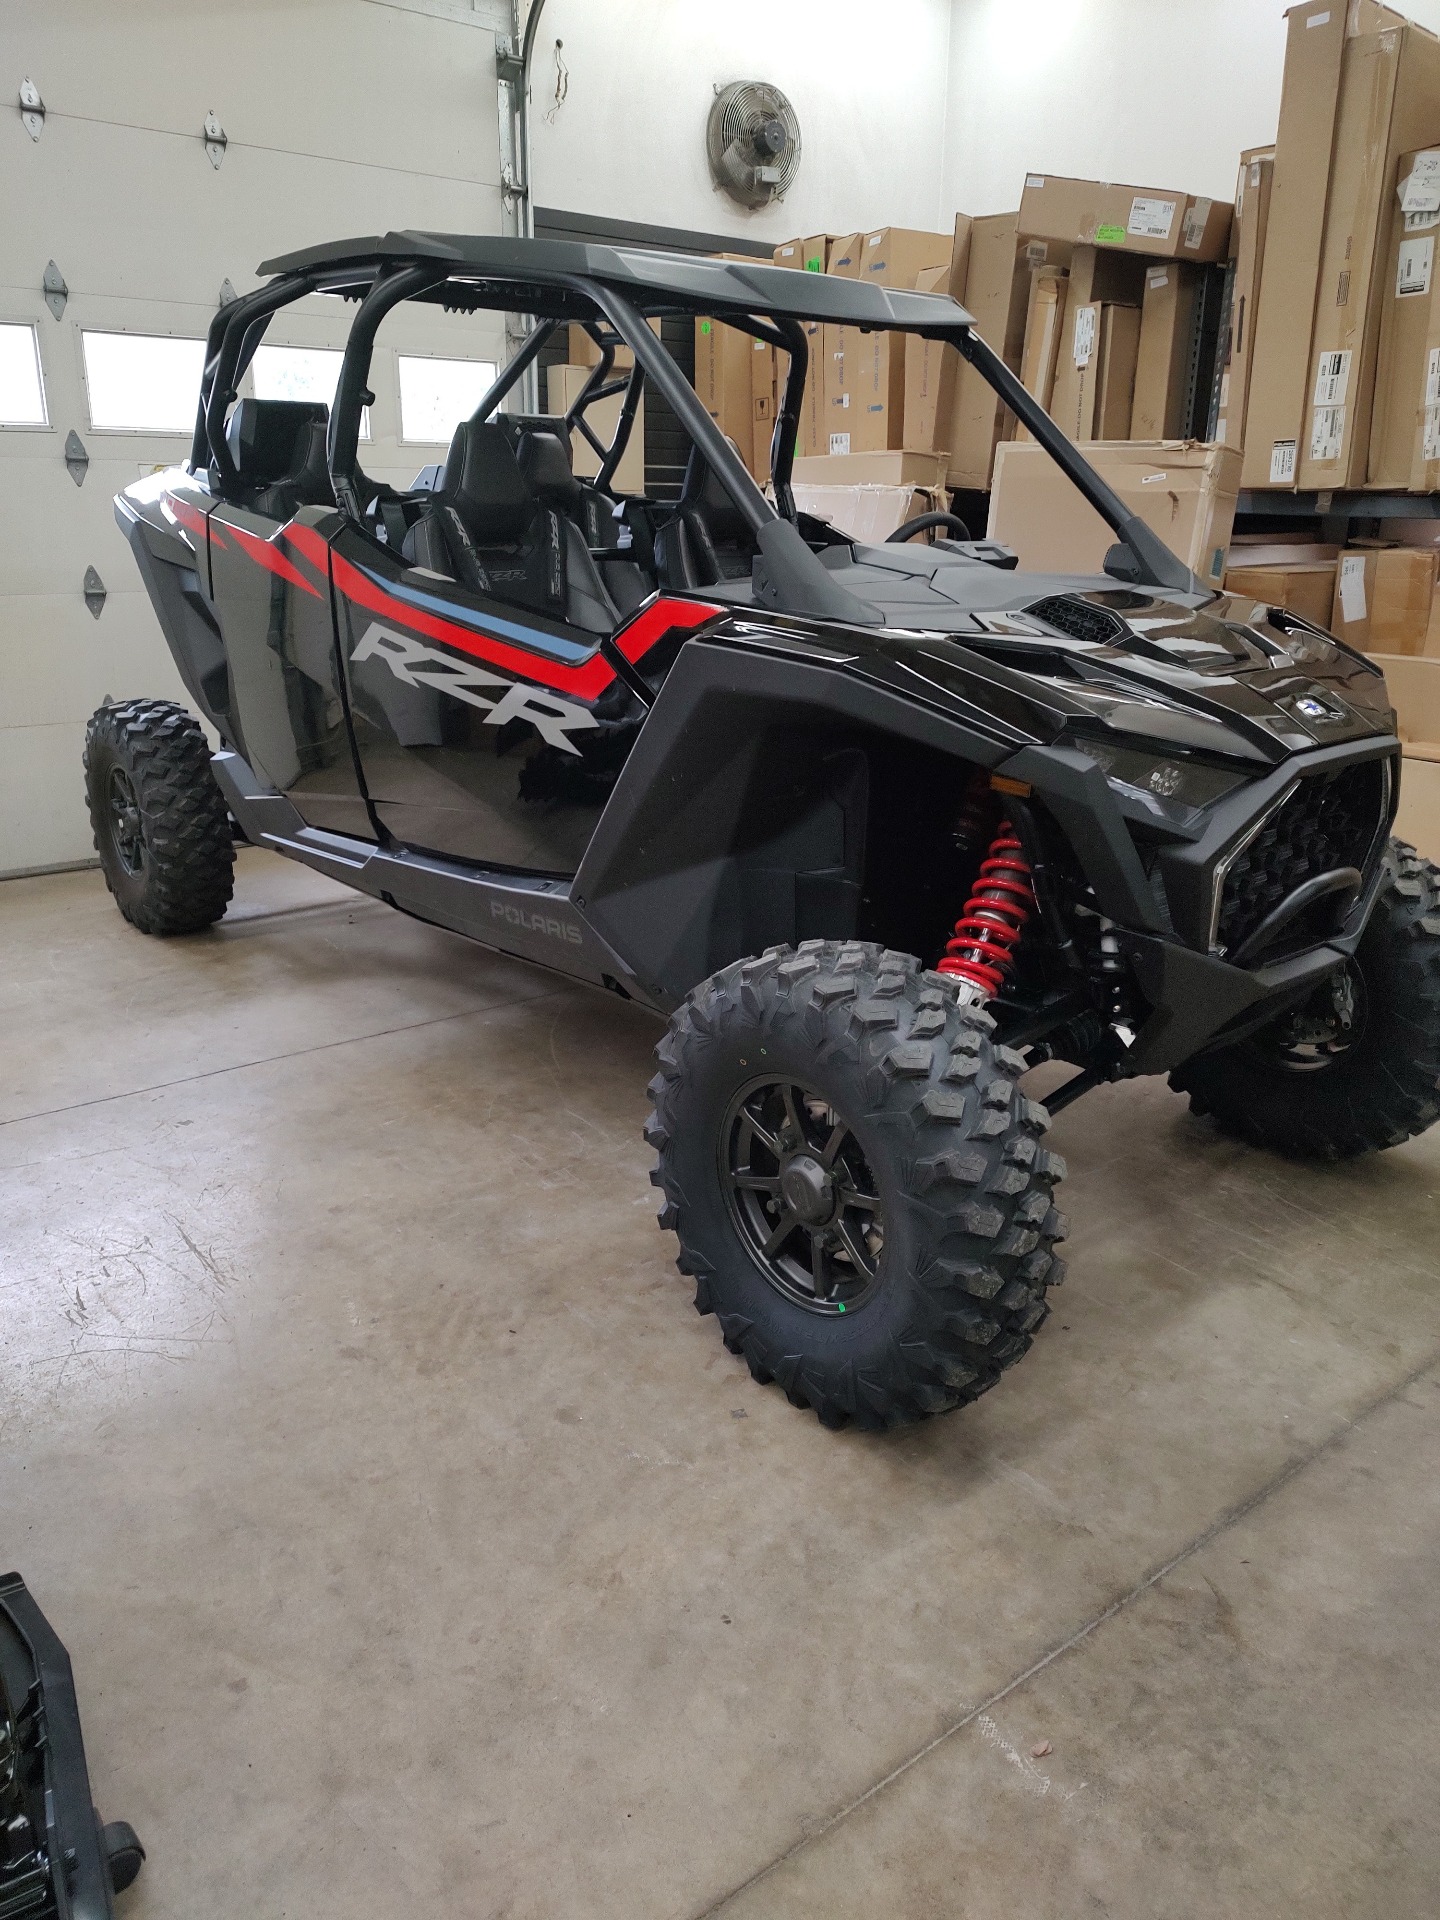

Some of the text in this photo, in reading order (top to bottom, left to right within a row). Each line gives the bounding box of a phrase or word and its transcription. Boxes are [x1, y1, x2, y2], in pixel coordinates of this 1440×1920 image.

[444, 506, 471, 546] RZR
[548, 509, 560, 550] RZR
[487, 568, 528, 581] ZR
[350, 621, 600, 758] RZR
[490, 901, 583, 945] POLARIS
